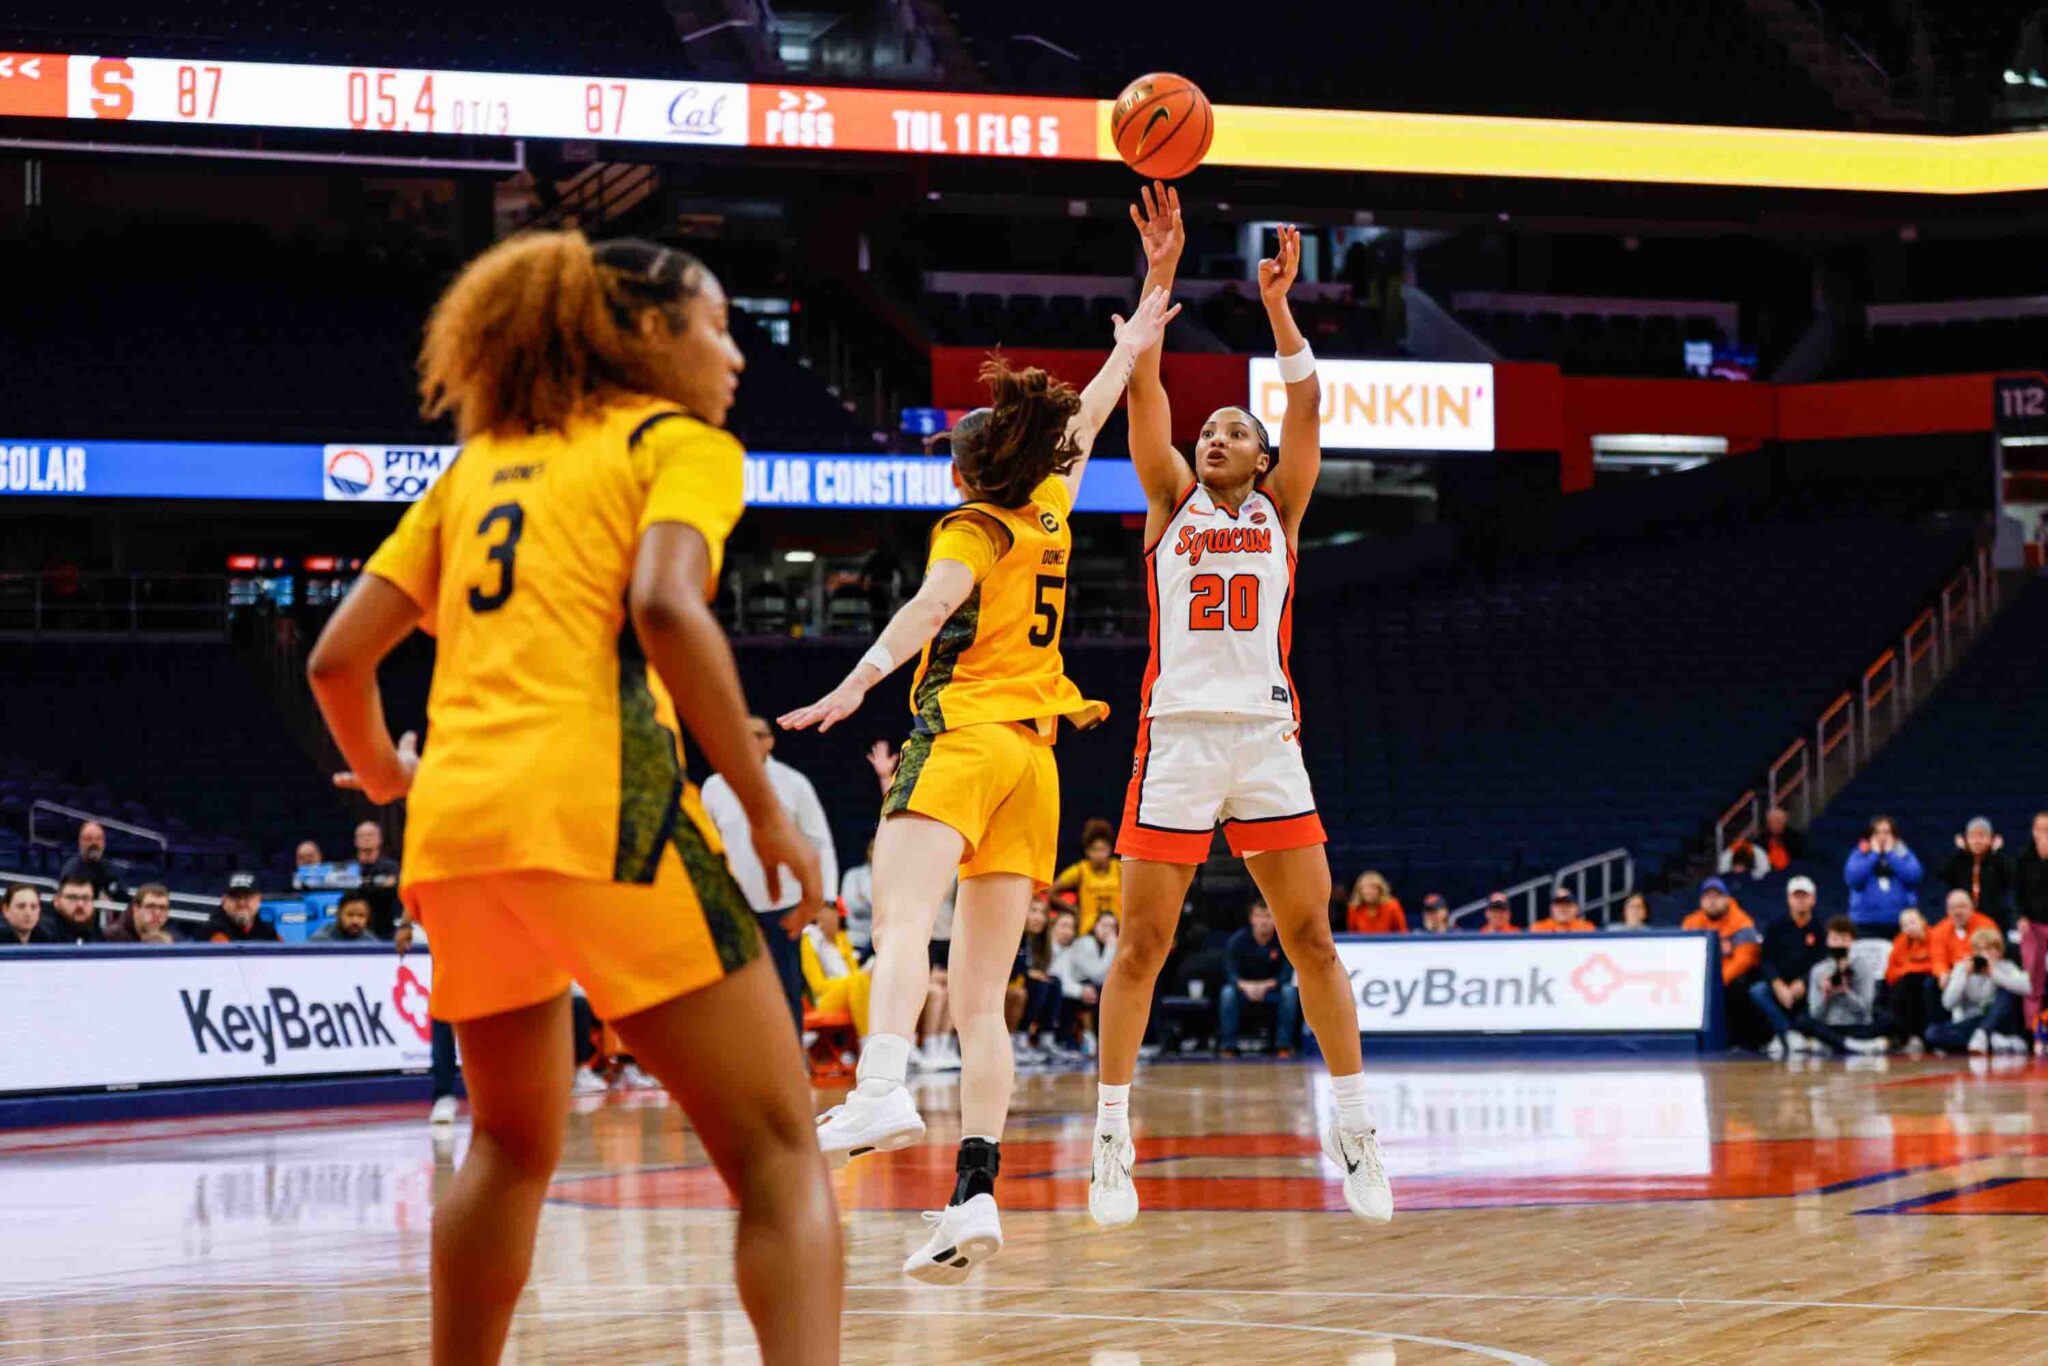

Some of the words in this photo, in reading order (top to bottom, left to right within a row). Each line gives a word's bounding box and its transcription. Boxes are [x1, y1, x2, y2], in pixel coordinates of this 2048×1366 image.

[91, 58, 134, 120] S
[177, 65, 222, 118] 87
[348, 72, 436, 133] 05.4
[585, 83, 628, 135] 87
[667, 87, 728, 136] Cal
[765, 109, 835, 147] POSS
[891, 109, 948, 153] TOL
[955, 112, 970, 154] 1
[978, 113, 1032, 156] FLS
[1039, 115, 1060, 157] 5
[2001, 388, 2046, 416] 112
[386, 451, 441, 471] PTM
[468, 500, 525, 615] 3
[1028, 573, 1065, 648] 5
[1189, 573, 1260, 631] 20
[179, 985, 396, 1066] KeyBank
